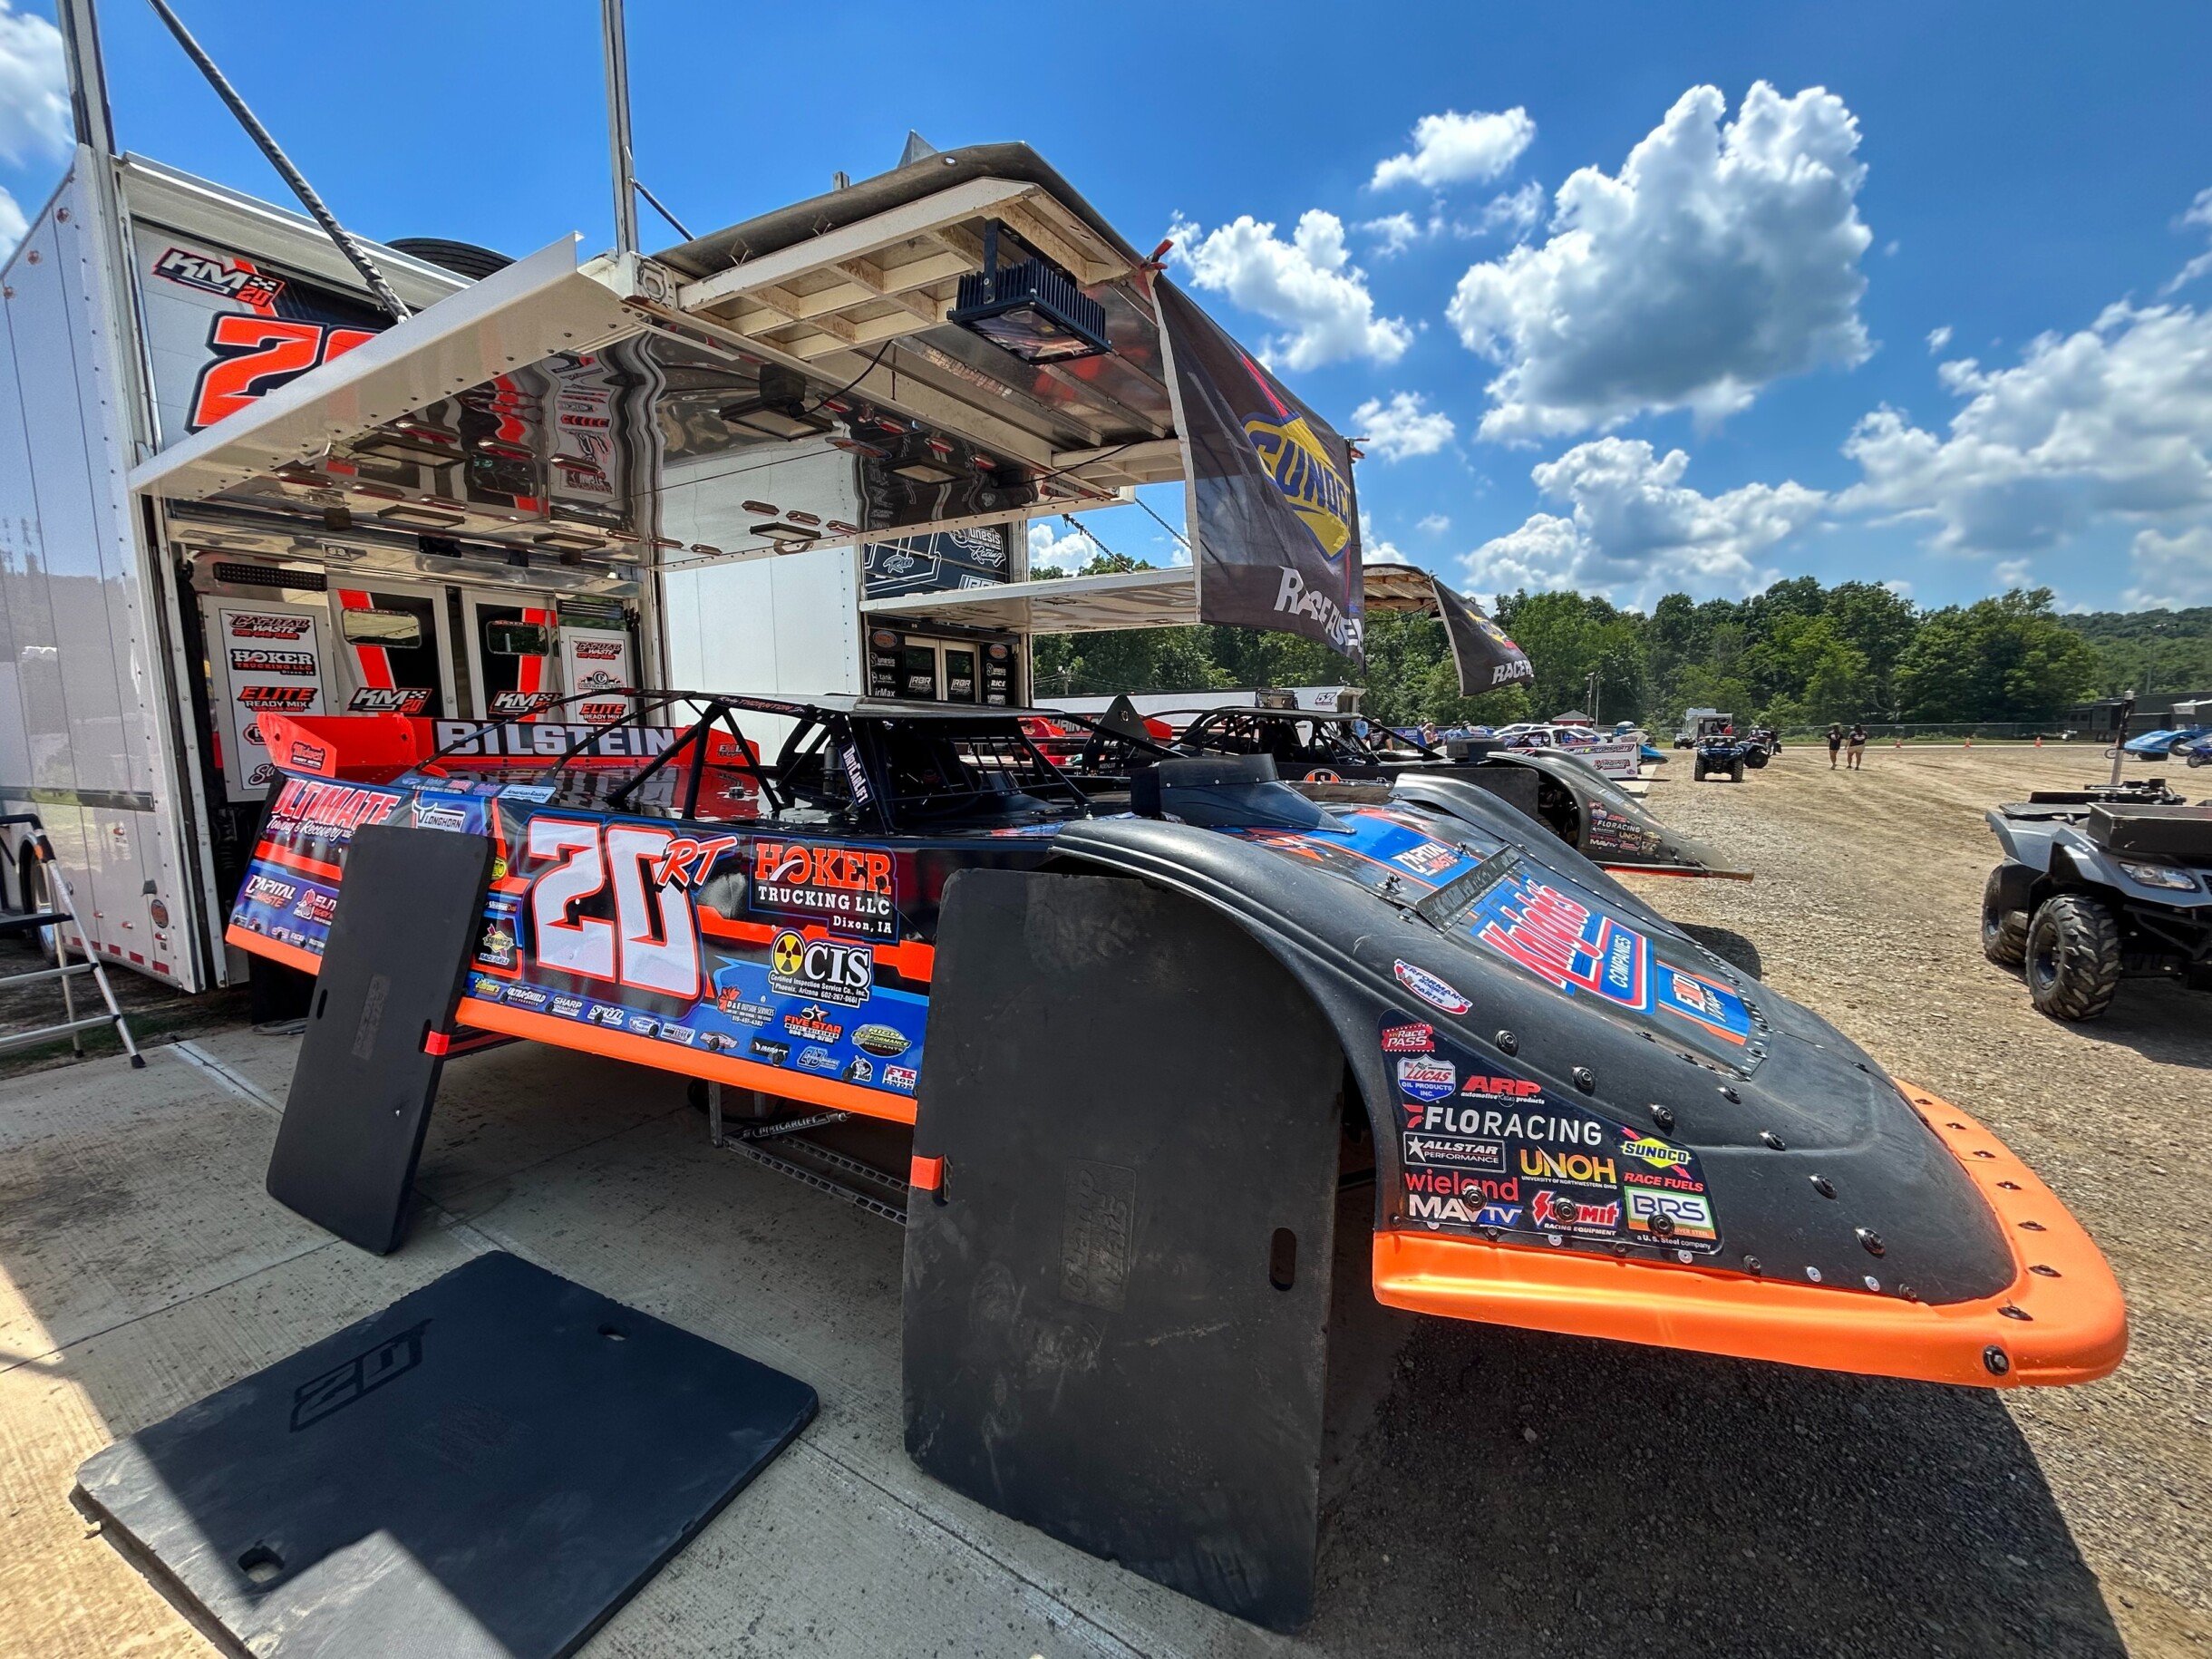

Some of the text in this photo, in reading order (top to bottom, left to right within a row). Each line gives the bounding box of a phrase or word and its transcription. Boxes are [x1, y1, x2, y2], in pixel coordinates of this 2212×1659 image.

[186, 310, 385, 435] 2
[1248, 428, 1351, 526] SUNOC
[972, 544, 1004, 566] Racing
[227, 614, 310, 628] CAPITAL
[253, 625, 297, 633] WASTE
[233, 650, 314, 665] HOKER
[240, 687, 315, 701] ELITE
[353, 689, 425, 713] KM 20
[581, 704, 626, 714] ELITE
[436, 721, 679, 755] BILSTEIN
[271, 777, 402, 835] ULTIMATE
[266, 815, 295, 834] Towing
[299, 820, 344, 841] Recovery
[424, 816, 463, 829] LONGHORN
[1597, 820, 1641, 833] FLORACING
[1391, 841, 1448, 874] CAPITAL
[755, 842, 892, 895] HOKER
[245, 875, 297, 900] CAPITAL
[314, 895, 338, 912] ELIT
[528, 815, 739, 1001] 20 RT
[758, 886, 890, 916] TRUCKING LLC
[833, 915, 892, 934] Dixon, IA
[804, 946, 869, 987] CIS
[1608, 934, 1632, 989] COMPANIES
[771, 974, 794, 984] Certified
[793, 978, 820, 989] Inspection
[820, 983, 842, 993] Service
[798, 986, 819, 996] Arizona
[1394, 958, 1473, 1007] PERFORMANCE
[1412, 983, 1445, 1004] PARTS
[553, 996, 583, 1009] SHARP
[784, 1015, 810, 1027] FIVE
[811, 1020, 843, 1033] STAR
[868, 1026, 901, 1039] HIGH
[854, 1031, 912, 1046] PERFORMANCE
[1387, 1036, 1429, 1048] PASS
[888, 1065, 917, 1081] FK
[891, 1075, 915, 1085] ROD
[1405, 1070, 1452, 1082] LUCAS
[882, 1079, 915, 1091] ENDS
[1415, 1082, 1453, 1092] PRODUCTS
[1460, 1074, 1543, 1098] ARP
[1420, 1090, 1435, 1098] INC.
[1460, 1091, 1499, 1101] automotive
[1515, 1096, 1545, 1105] products
[1424, 1105, 1602, 1146] FLORACING
[1421, 1140, 1499, 1156] ALLSTAR
[1625, 1142, 1689, 1163] SUNOCO
[1424, 1150, 1499, 1165] PERFORMANCE
[1519, 1146, 1617, 1185] UNOH
[1521, 1175, 1618, 1190] UNIVERSITY OF NORTHWESTERN OHIO
[1624, 1172, 1704, 1193] RACE FUELS
[1633, 1193, 1706, 1222] BRS
[1544, 1223, 1573, 1232] RACING
[1660, 1237, 1681, 1246] Steel
[1680, 1240, 1712, 1250] company
